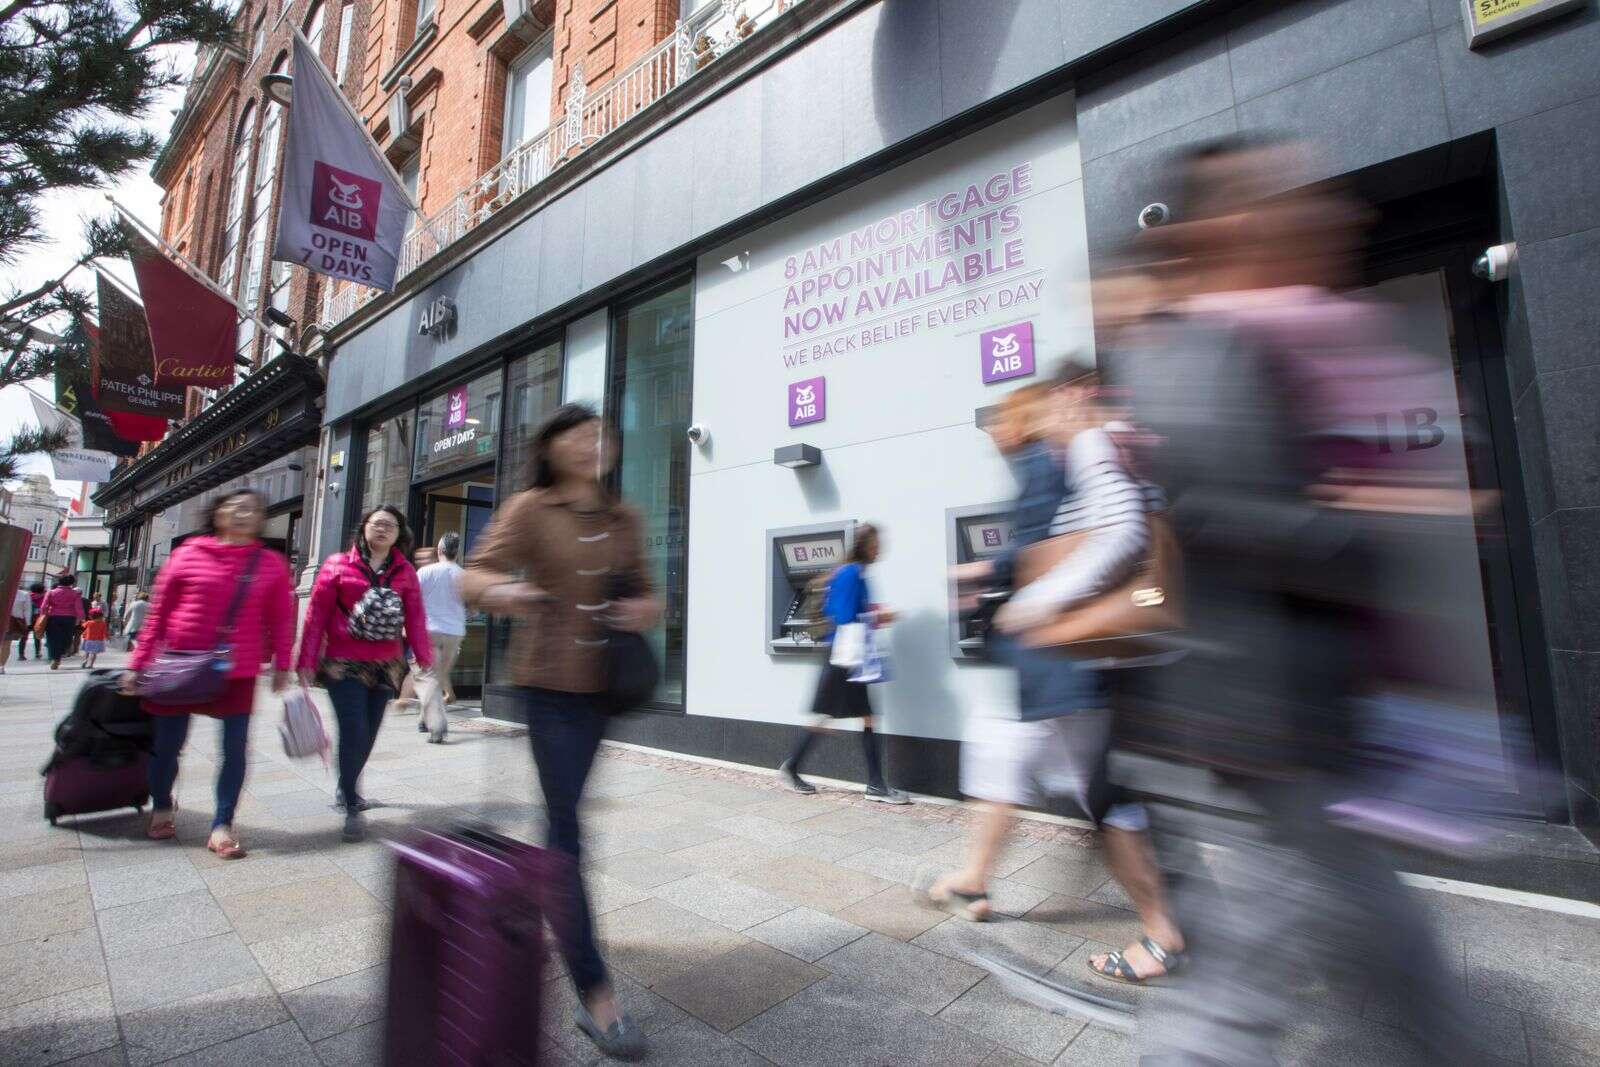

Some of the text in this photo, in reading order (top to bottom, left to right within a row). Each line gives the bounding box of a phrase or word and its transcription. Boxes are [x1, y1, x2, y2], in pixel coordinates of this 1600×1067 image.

[323, 205, 362, 230] AIB
[784, 160, 1032, 279] 8AM MORTGAGE
[311, 233, 367, 262] OPEN
[783, 204, 1021, 309] APPOINTMENTS
[301, 248, 373, 280] 7 DAYS
[784, 239, 1025, 339] NOW AVAILABLE
[417, 295, 449, 336] AIB
[783, 278, 1046, 368] WE BACK BELIEF EVERY DAY
[157, 357, 231, 379] Cartier
[992, 356, 1022, 375] AIB
[101, 379, 184, 405] PATEK PHILIPPE
[449, 410, 462, 425] AIB
[794, 404, 817, 420] AIB
[434, 434, 451, 453] OPEN
[457, 428, 475, 445] DAYS
[1374, 407, 1445, 454] IB
[812, 546, 835, 559] ATM
